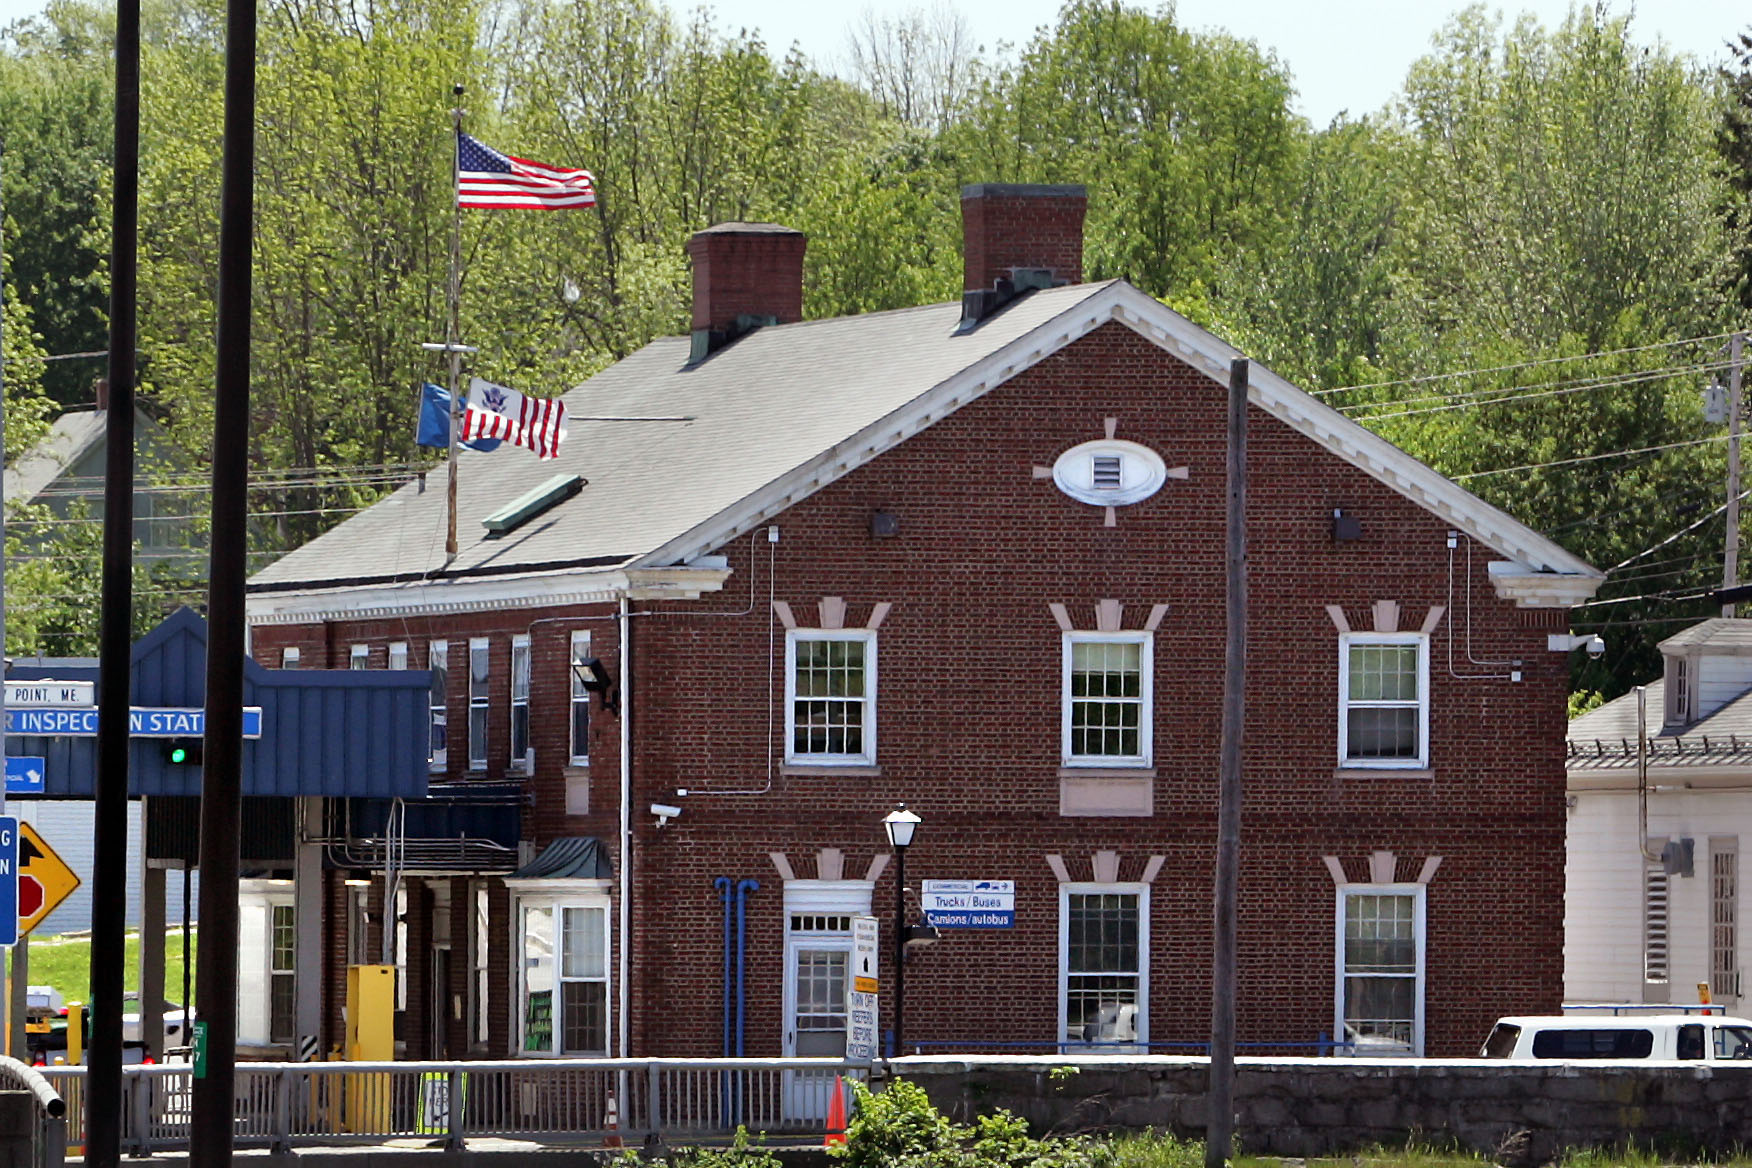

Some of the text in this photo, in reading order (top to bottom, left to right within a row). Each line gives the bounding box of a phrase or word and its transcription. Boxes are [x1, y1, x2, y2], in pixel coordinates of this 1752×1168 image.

[61, 688, 80, 702] ME.
[21, 711, 143, 732] INSPECN
[150, 712, 201, 732] STAT
